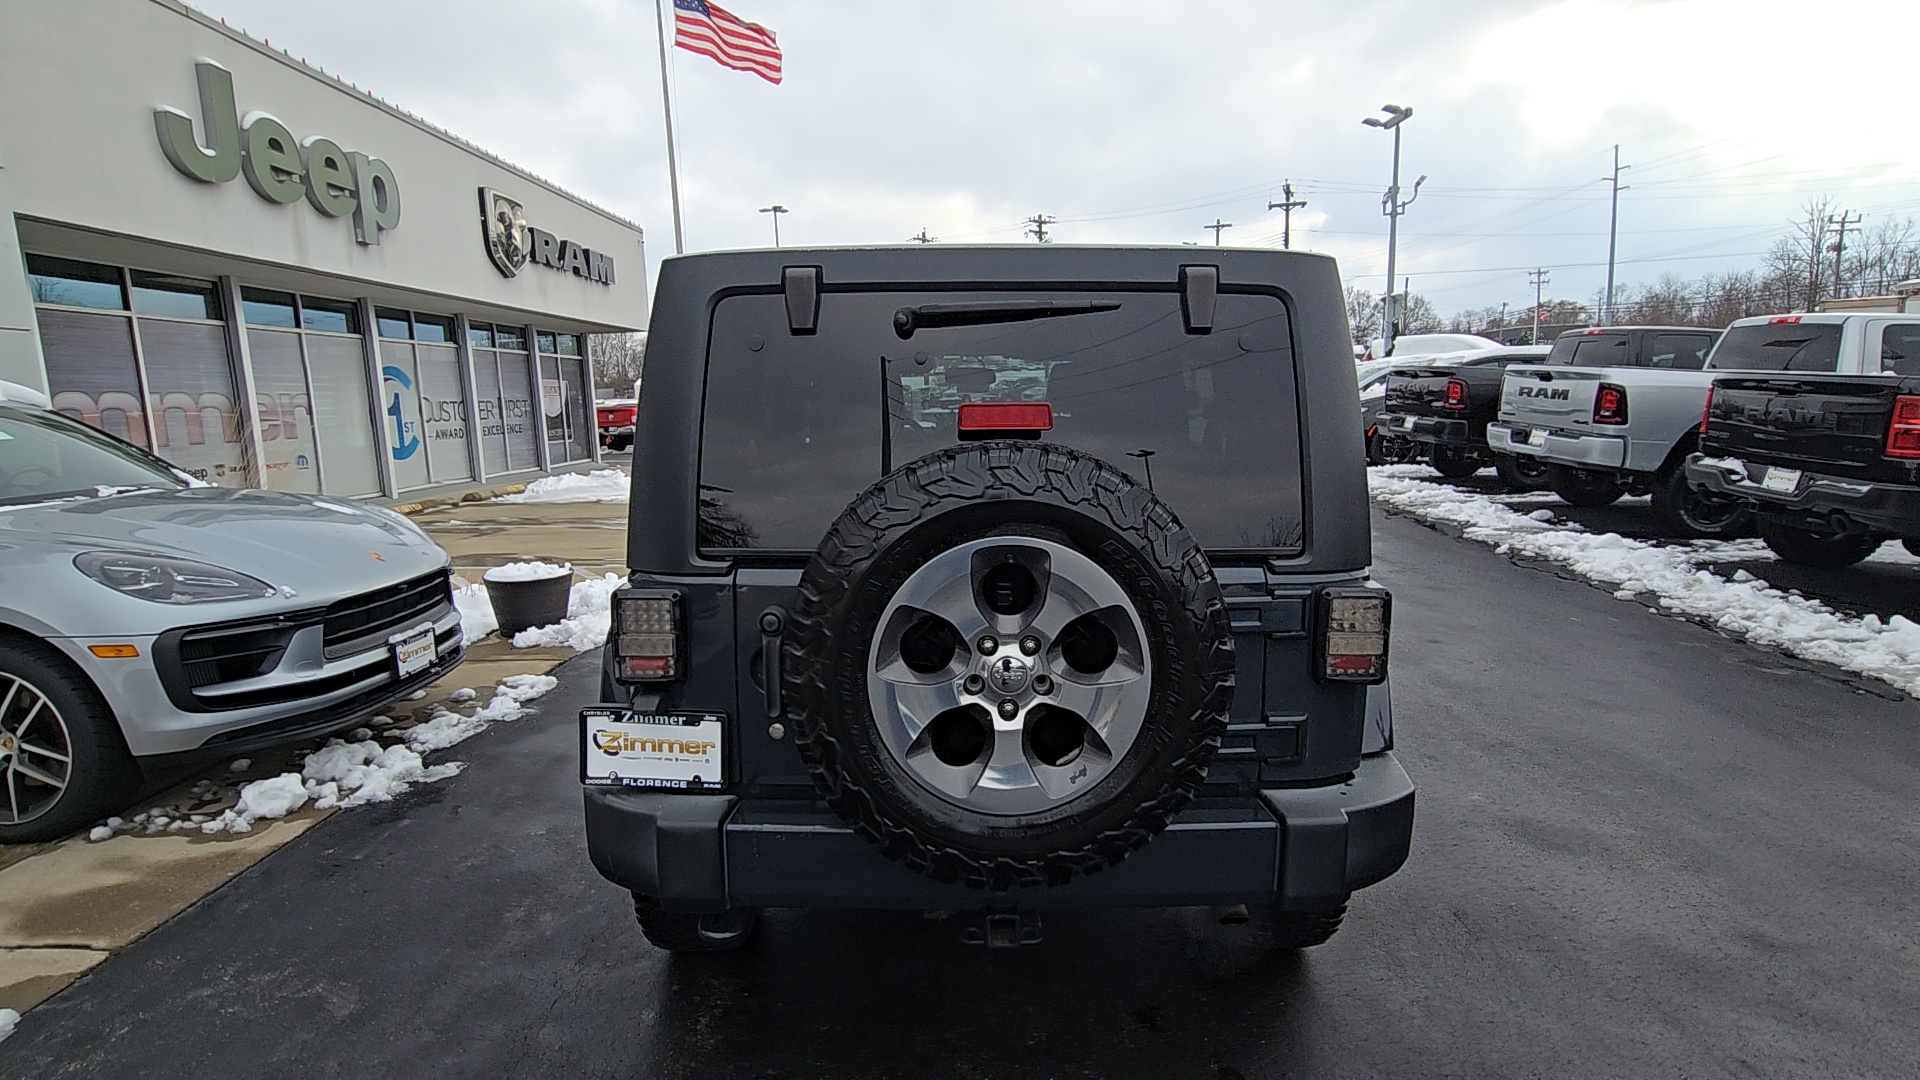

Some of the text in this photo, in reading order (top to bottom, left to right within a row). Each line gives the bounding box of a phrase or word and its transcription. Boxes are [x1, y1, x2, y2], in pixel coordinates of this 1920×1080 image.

[153, 57, 401, 246] Jeep
[528, 227, 616, 285] RAM
[1518, 386, 1570, 400] RAM
[419, 396, 496, 423] CUSTOER
[434, 428, 465, 440] AWARD
[601, 731, 717, 756] Zimmer
[622, 778, 688, 789] FLORENCE
